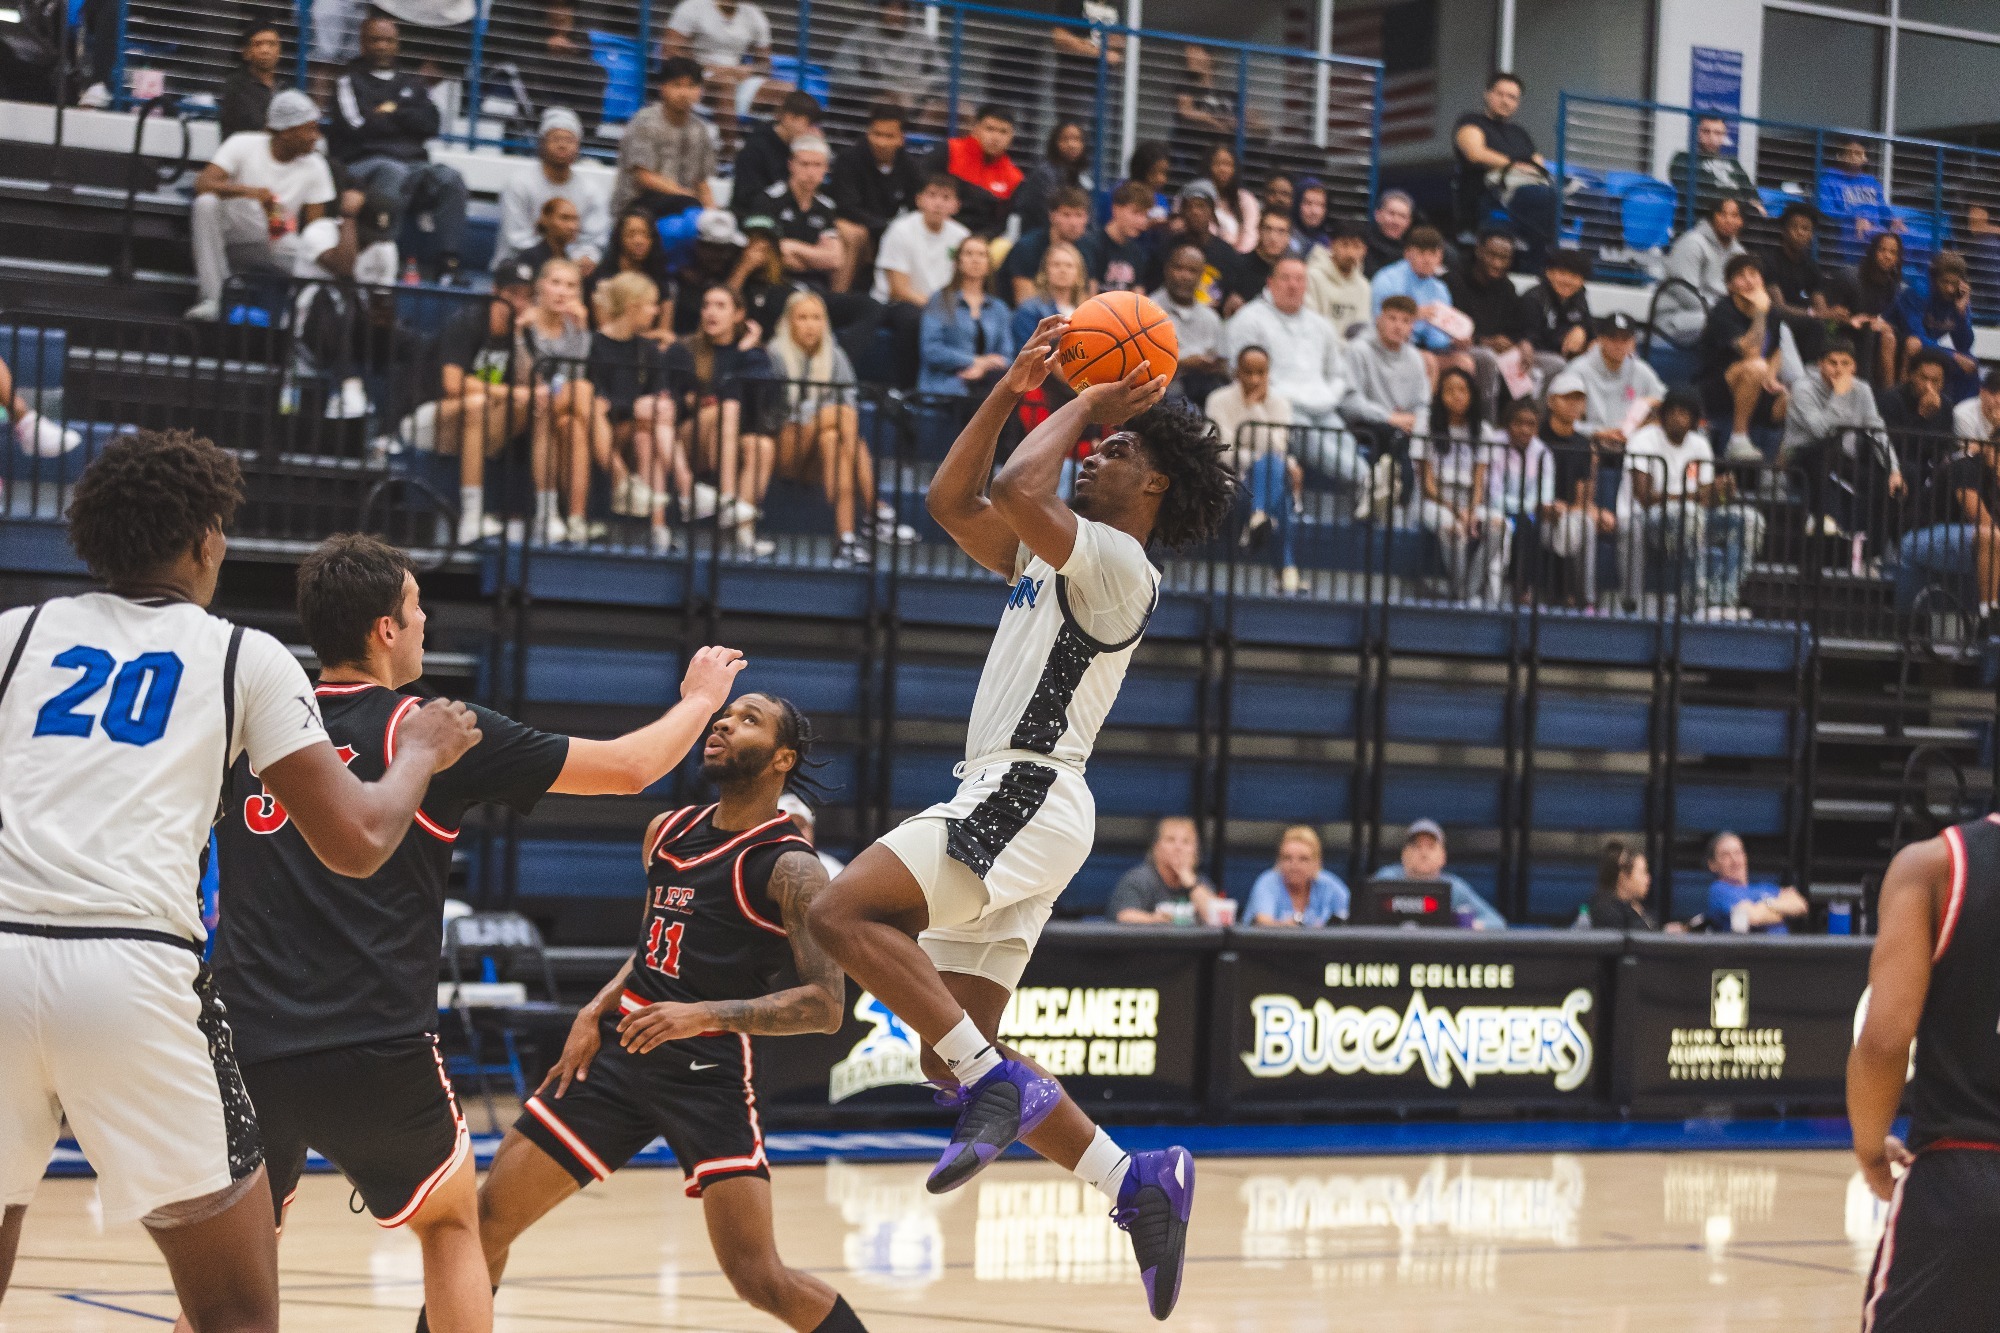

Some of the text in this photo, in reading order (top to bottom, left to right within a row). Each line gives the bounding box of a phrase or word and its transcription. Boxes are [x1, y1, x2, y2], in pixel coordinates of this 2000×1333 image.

[32, 644, 184, 747] 20
[653, 885, 695, 915] LEE
[646, 916, 685, 979] 11
[1325, 963, 1515, 988] BLINN COLLEGE
[998, 986, 1159, 1038] UCCANEER
[1088, 1039, 1156, 1076] CLUB
[1240, 988, 1593, 1091] BUCCANEERS
